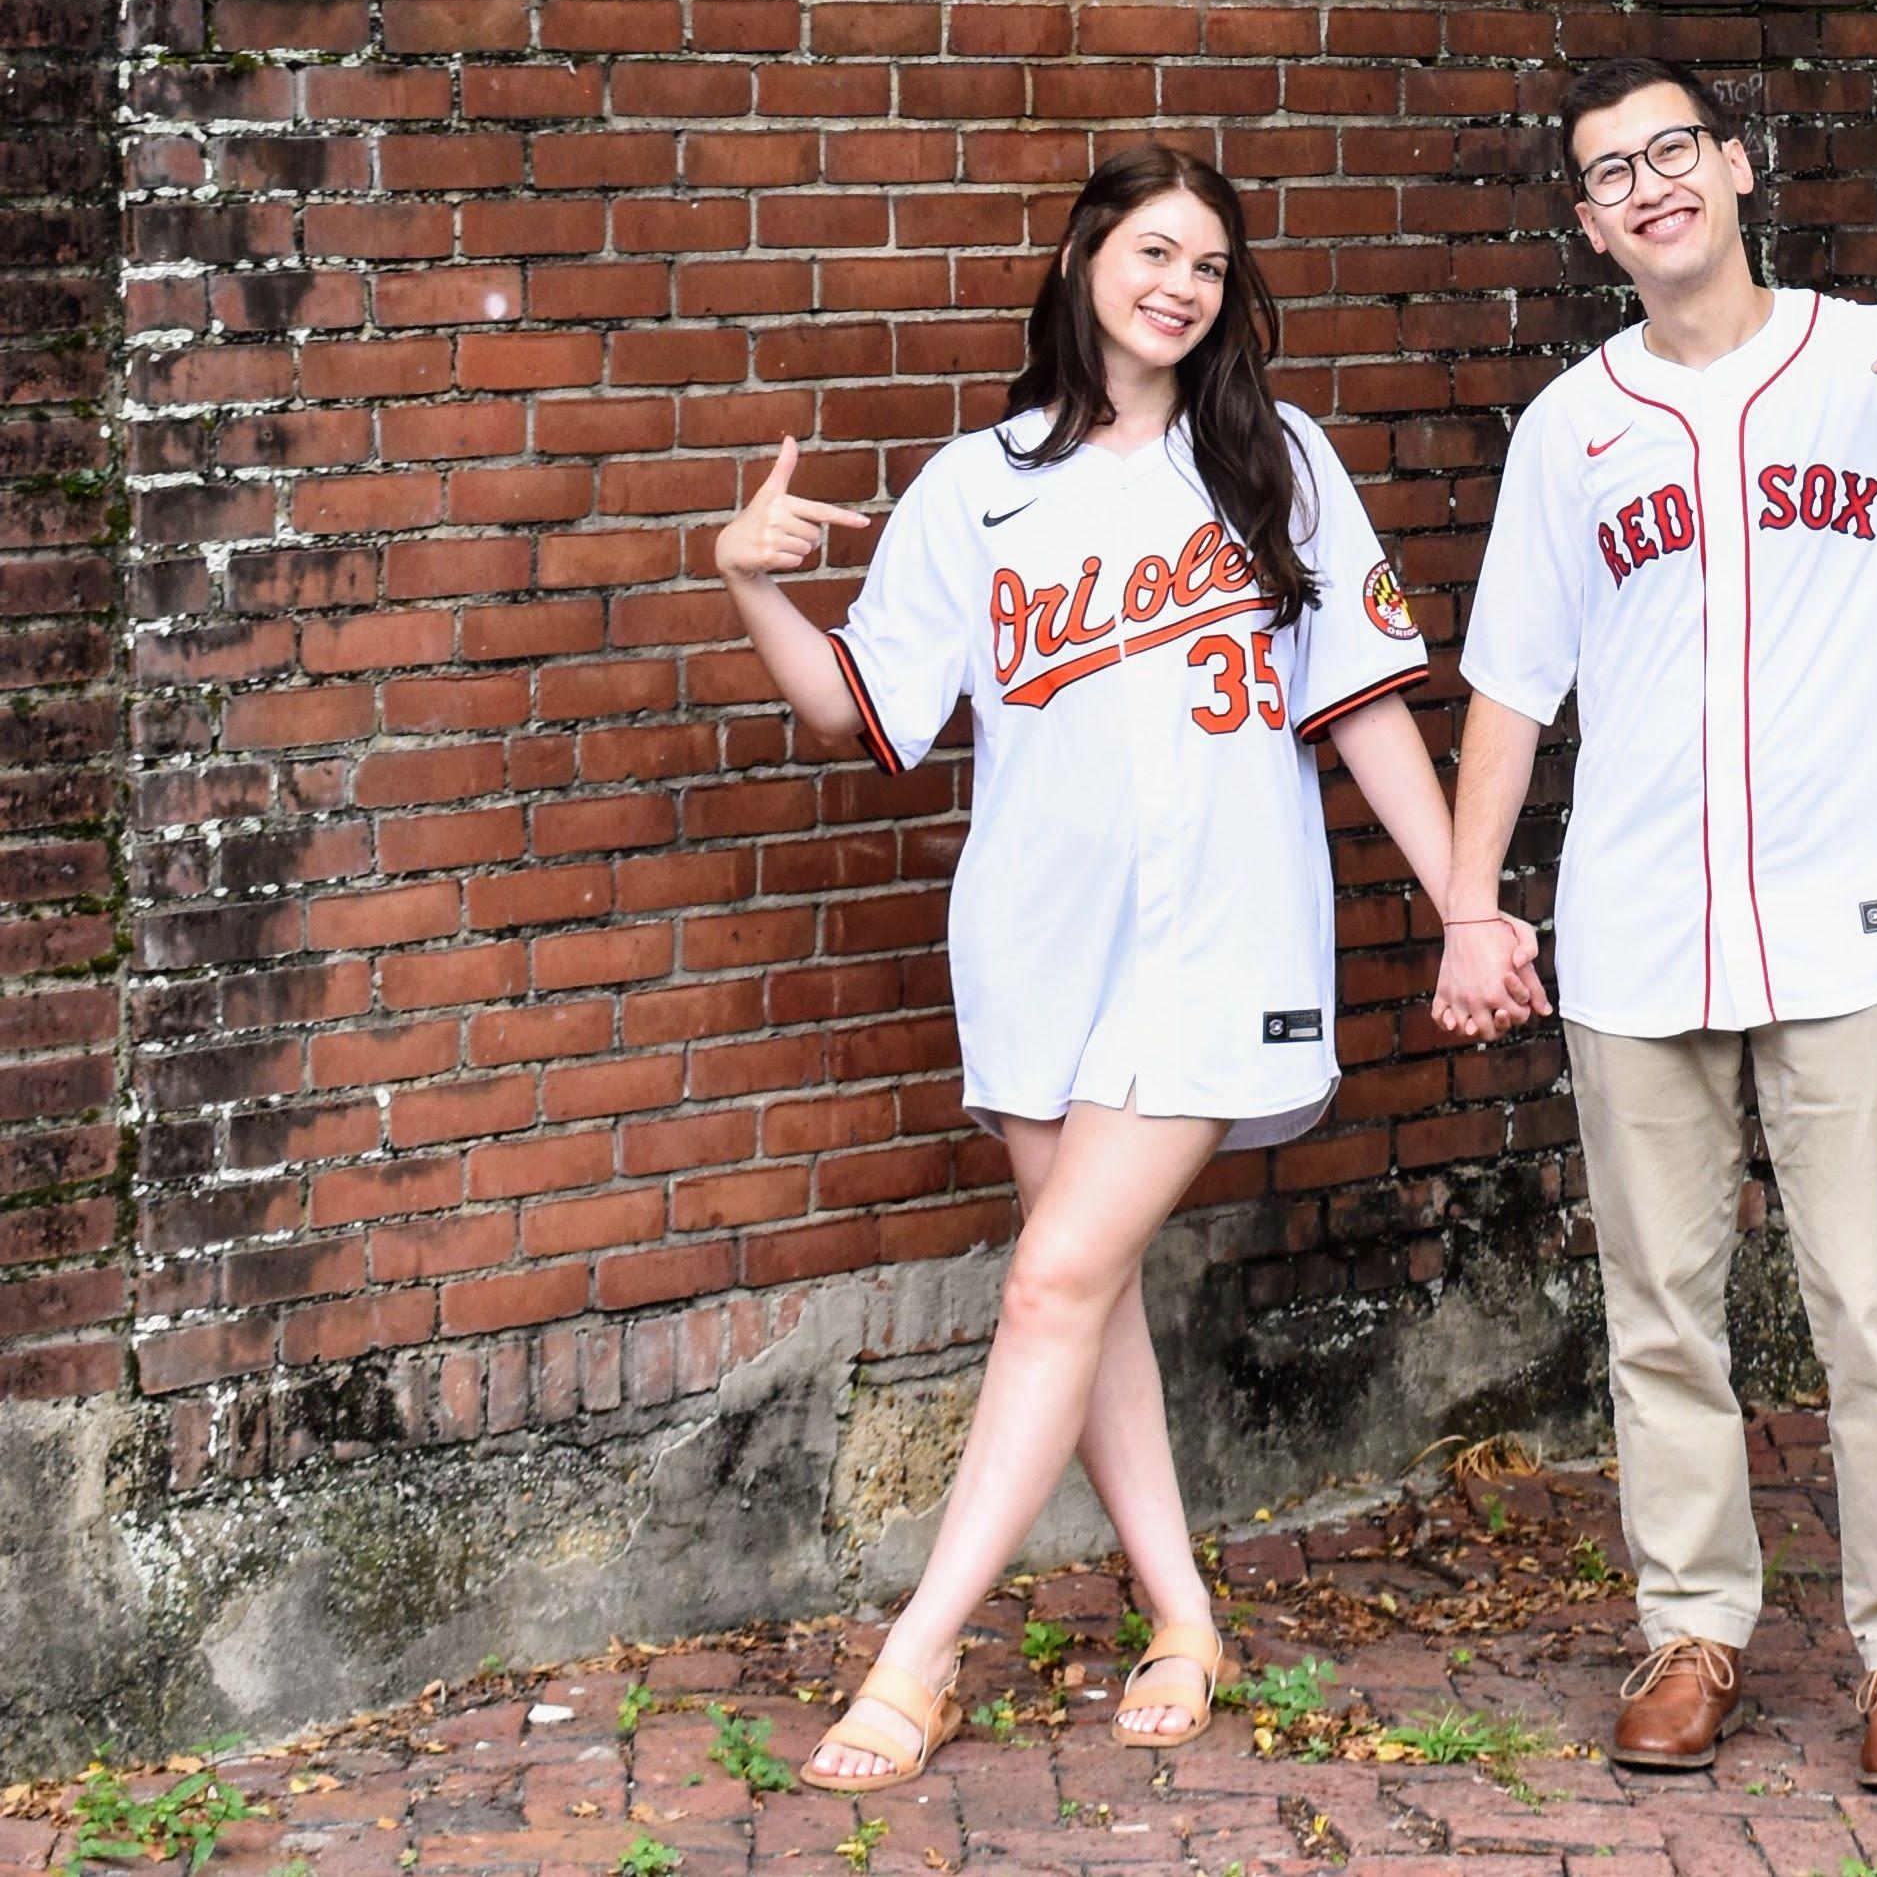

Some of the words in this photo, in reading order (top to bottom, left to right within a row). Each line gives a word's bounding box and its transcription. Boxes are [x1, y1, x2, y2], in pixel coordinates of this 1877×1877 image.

[1598, 484, 1695, 591] RED
[990, 521, 1258, 685] Oriole
[1187, 632, 1287, 735] 35
